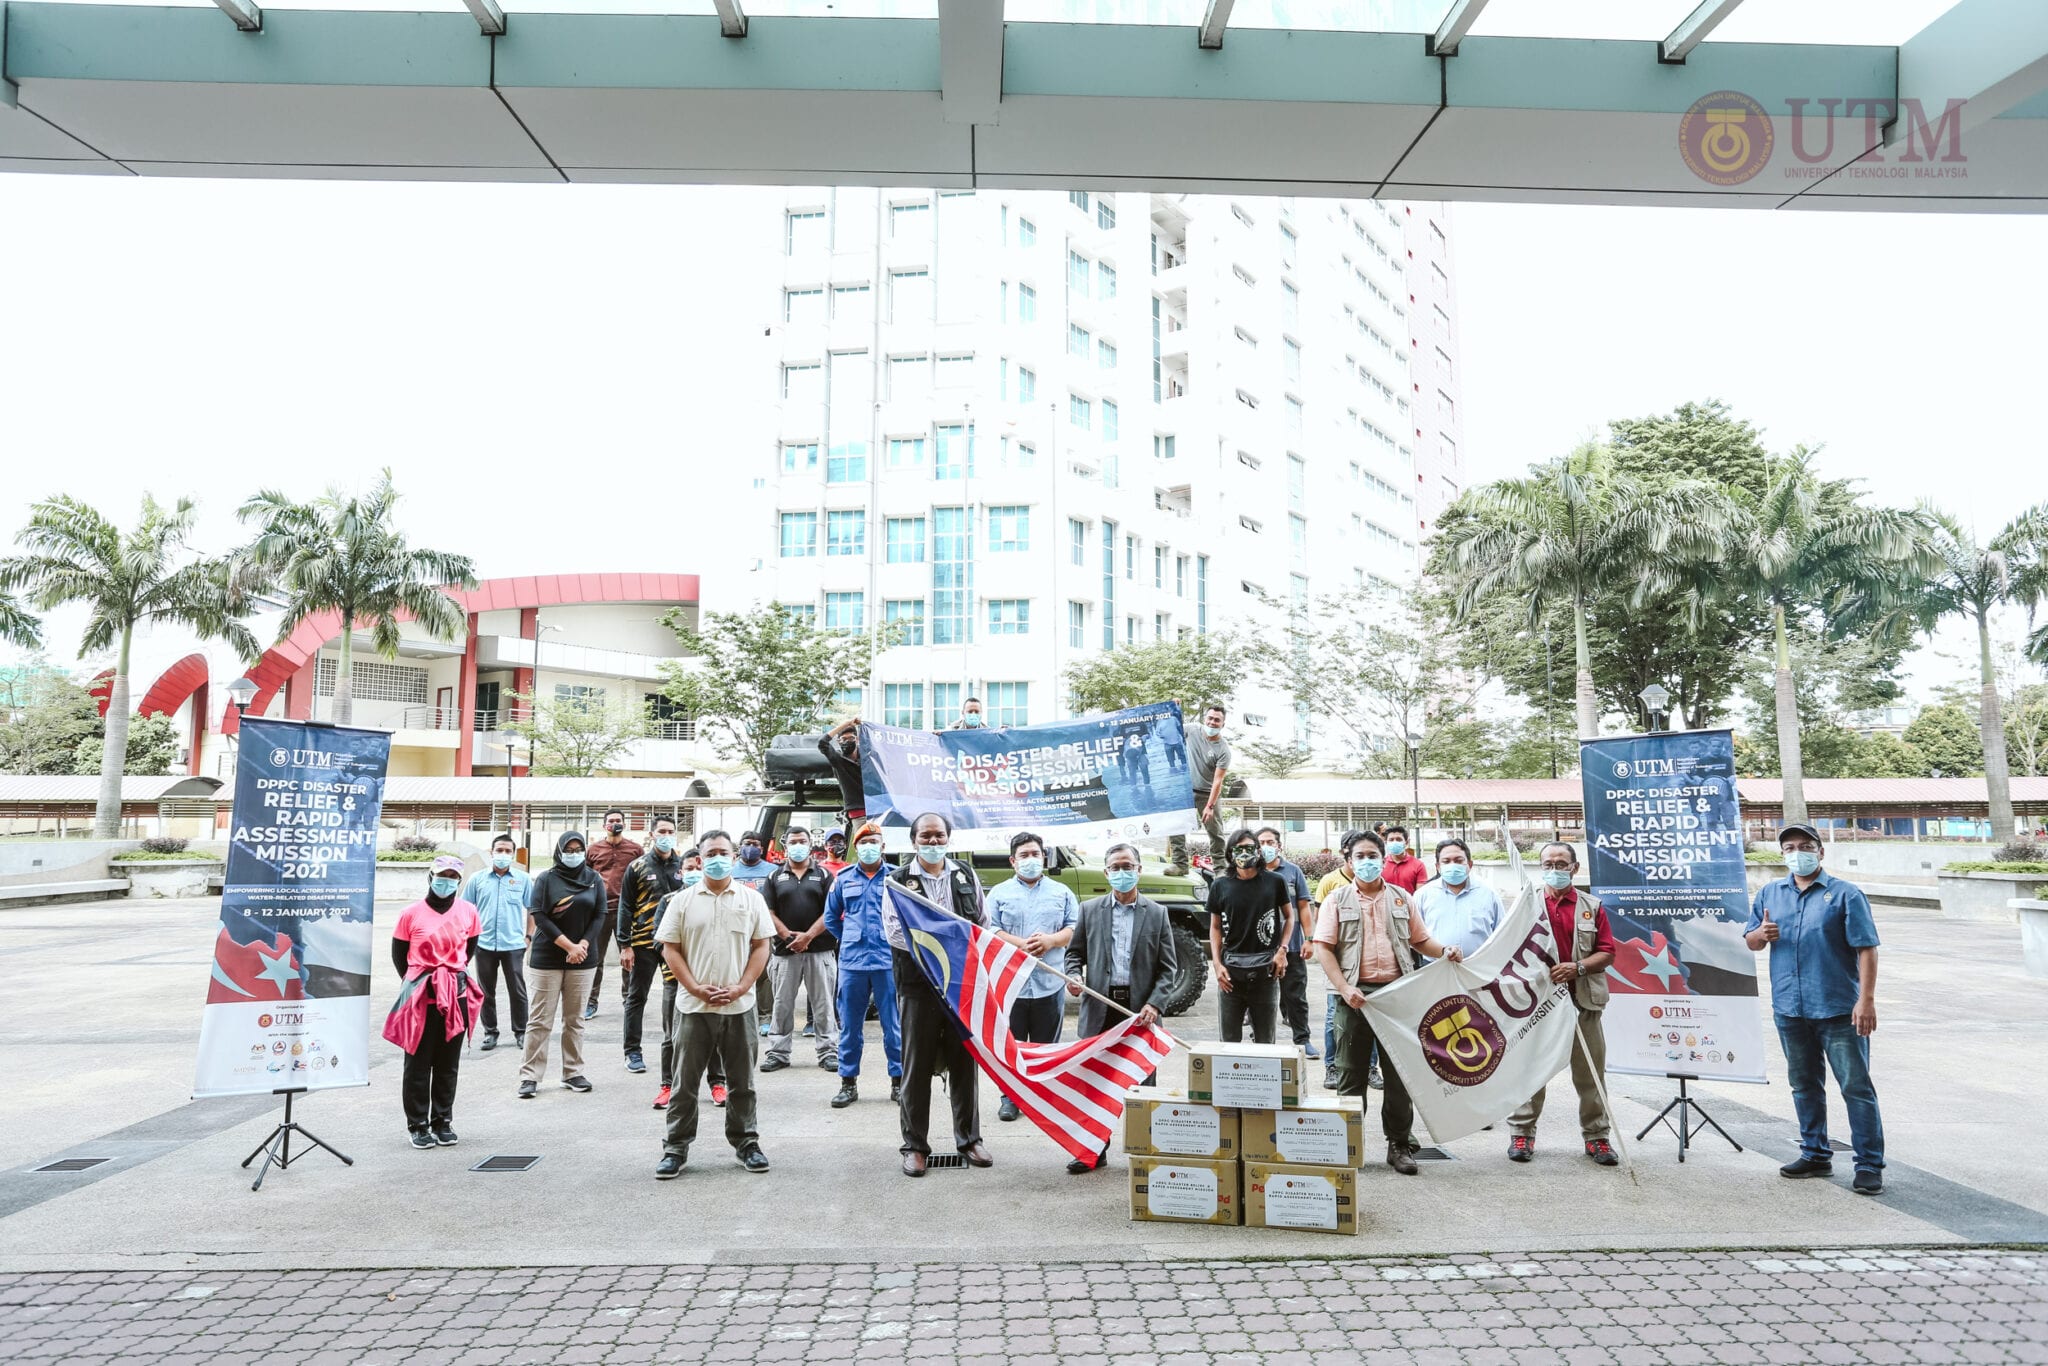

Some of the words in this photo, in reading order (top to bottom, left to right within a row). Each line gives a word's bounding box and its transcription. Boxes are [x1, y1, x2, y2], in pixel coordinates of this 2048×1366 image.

[1119, 715, 1154, 726] JANUARY
[1155, 712, 1171, 721] 2021
[887, 731, 913, 747] UTM
[293, 749, 332, 766] UTM
[907, 752, 956, 769] DPPC
[962, 744, 1059, 769] DISASTER
[1060, 736, 1124, 757] RELIEF
[1129, 734, 1143, 748] &
[931, 769, 990, 782] RAPID
[995, 752, 1120, 780] ASSESSMENT
[1634, 759, 1674, 774] UTM
[257, 779, 298, 791] DPPC
[303, 781, 366, 795] DISASTER
[965, 779, 1044, 797] MISSION
[1051, 772, 1091, 790] 2021
[1606, 788, 1645, 800] DPPC
[1649, 785, 1719, 798] DISASTER
[264, 792, 338, 809] RELIEF
[342, 796, 356, 811] &
[1072, 789, 1109, 799] REDUCING
[1036, 802, 1069, 811] DISASTER
[1071, 800, 1087, 808] RISK
[1615, 799, 1689, 815] RELIEF
[1696, 798, 1711, 812] &
[276, 810, 342, 827] RAPID
[1630, 816, 1699, 831] RAPID
[233, 827, 375, 845] ASSESSMENT
[1595, 830, 1739, 848] ASSESSMENT
[255, 845, 348, 861] MISSION
[1619, 848, 1711, 864] MISSION
[282, 863, 327, 879] 2021
[1646, 865, 1692, 880] 2021
[243, 908, 251, 917] 8
[262, 908, 273, 917] 12
[275, 908, 327, 917] JANUARY
[329, 908, 350, 916] 2021
[1647, 908, 1699, 916] JANUARY
[1702, 908, 1725, 916] 2021
[1481, 910, 1557, 1018] UT
[275, 1013, 304, 1024] UTM
[1424, 1004, 1442, 1026] TUHAN
[1443, 997, 1466, 1008] UNTUK
[1518, 999, 1556, 1039] UNIVERSITI
[1664, 1007, 1692, 1017] UTM
[1435, 1064, 1470, 1085] UNIVERSITI
[1470, 1057, 1499, 1085] TEKNOLOGI
